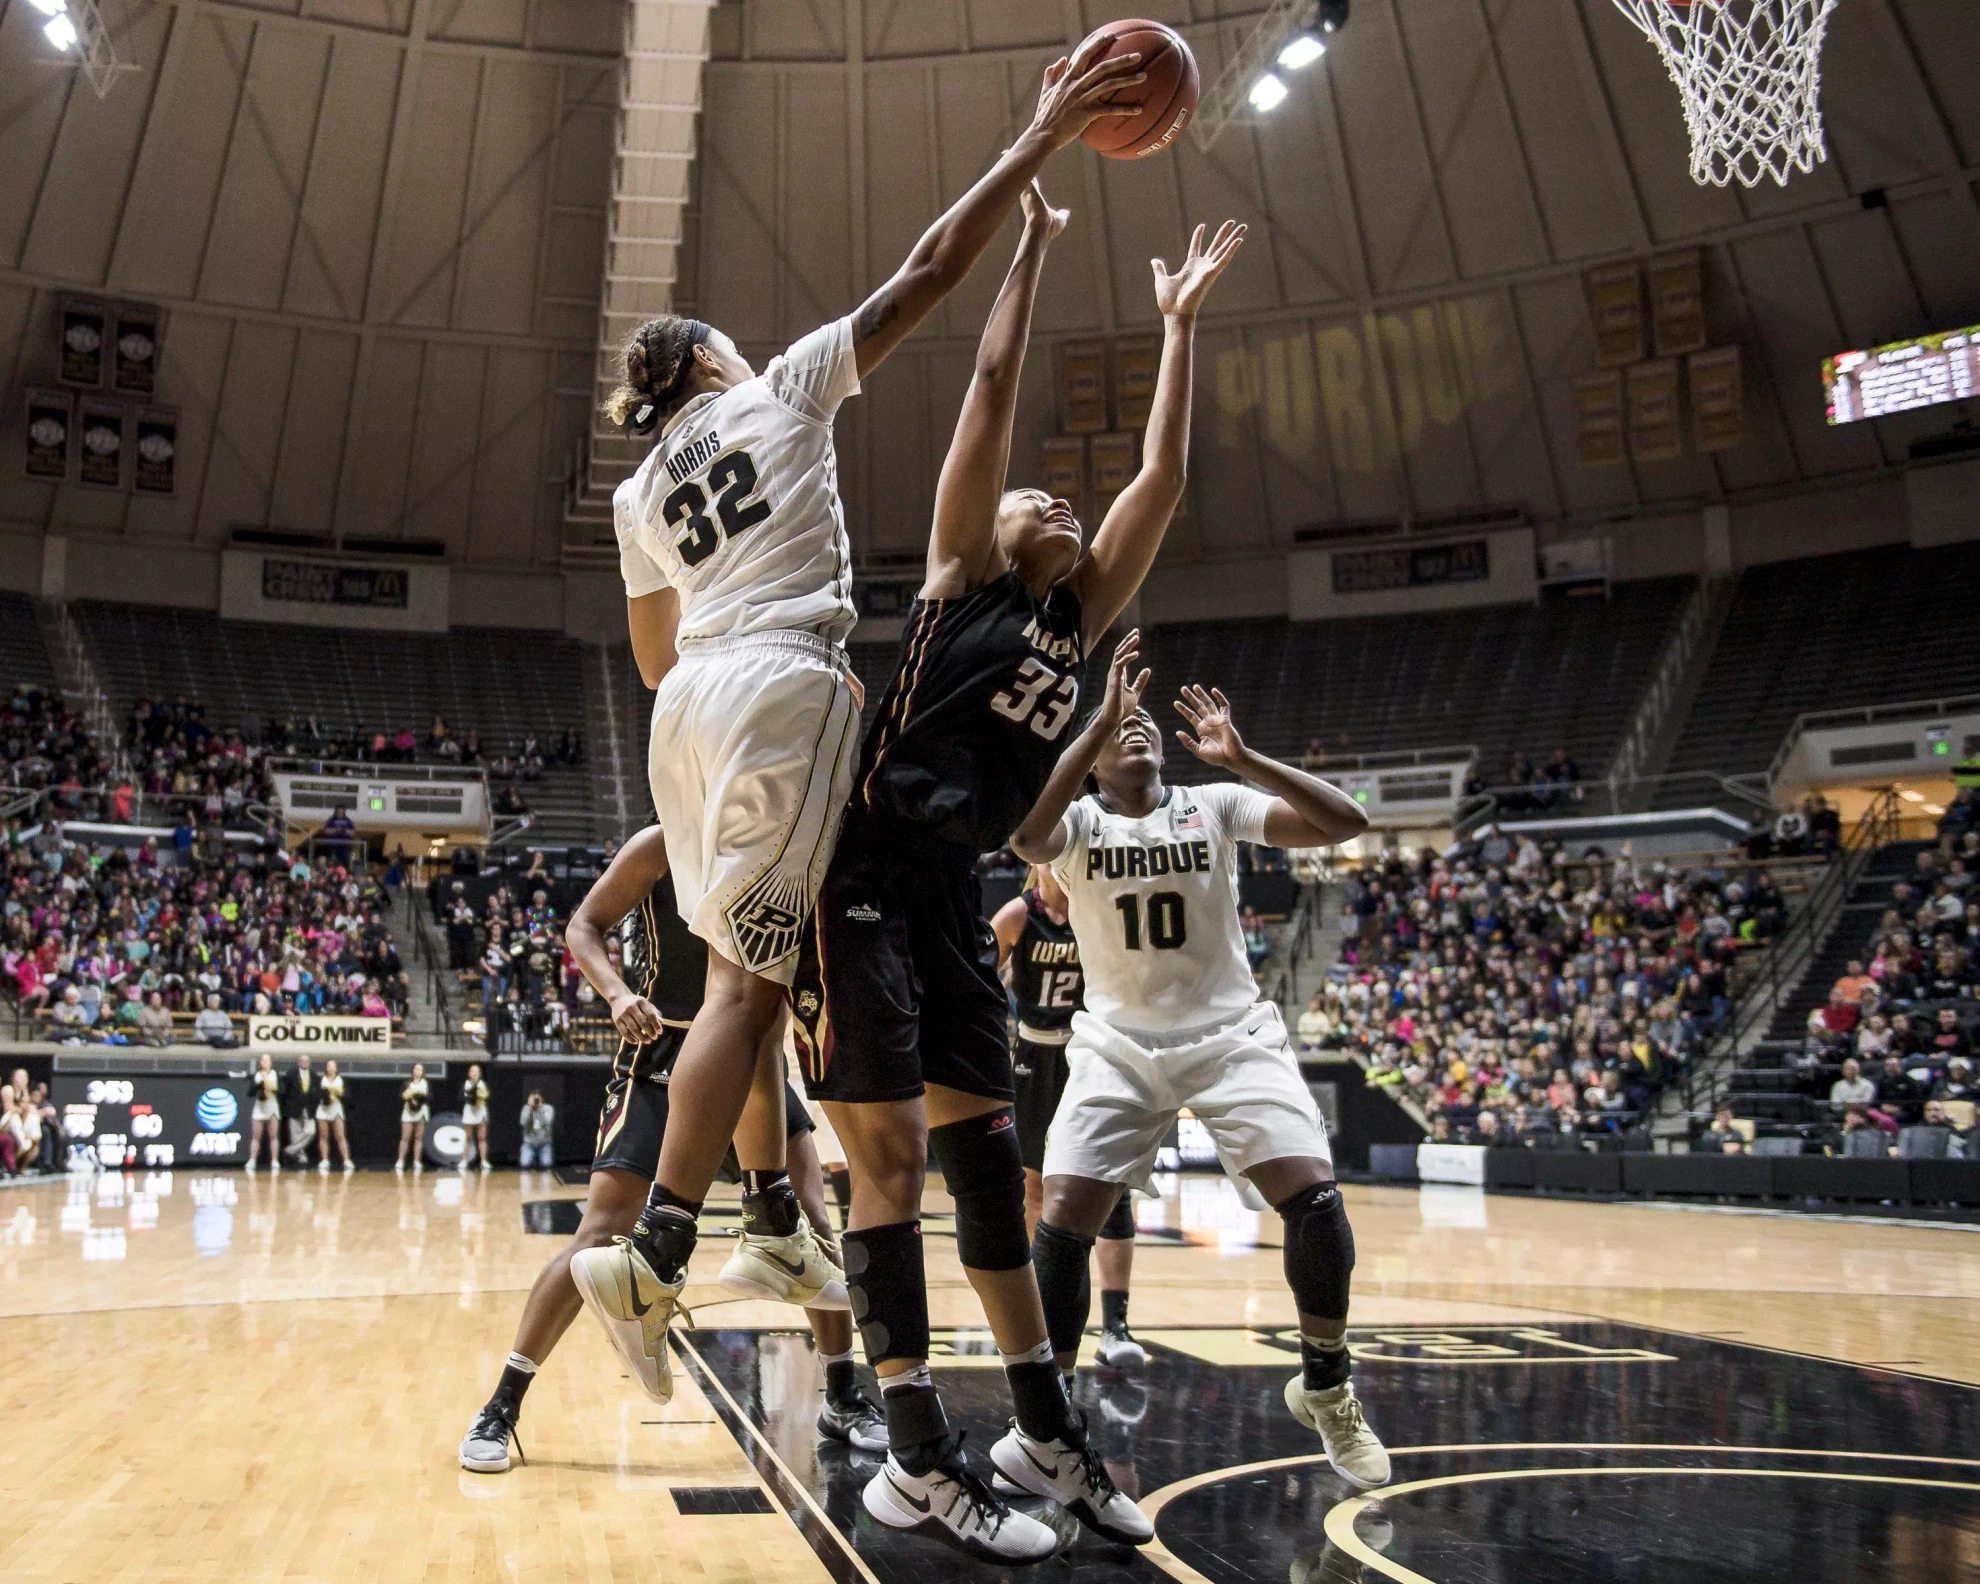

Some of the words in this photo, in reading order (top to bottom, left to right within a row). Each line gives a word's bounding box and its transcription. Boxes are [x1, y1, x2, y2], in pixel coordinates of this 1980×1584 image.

[664, 430, 721, 485] HARRIS
[662, 449, 774, 568] 32
[990, 657, 1079, 741] 33
[1086, 840, 1211, 881] PURDUE
[1114, 890, 1188, 951] 10
[1031, 940, 1080, 964] IUPU
[1038, 971, 1080, 1008] 12
[254, 1024, 322, 1041] GOLD
[324, 1026, 387, 1042] MINE
[189, 1132, 242, 1155] AT&T
